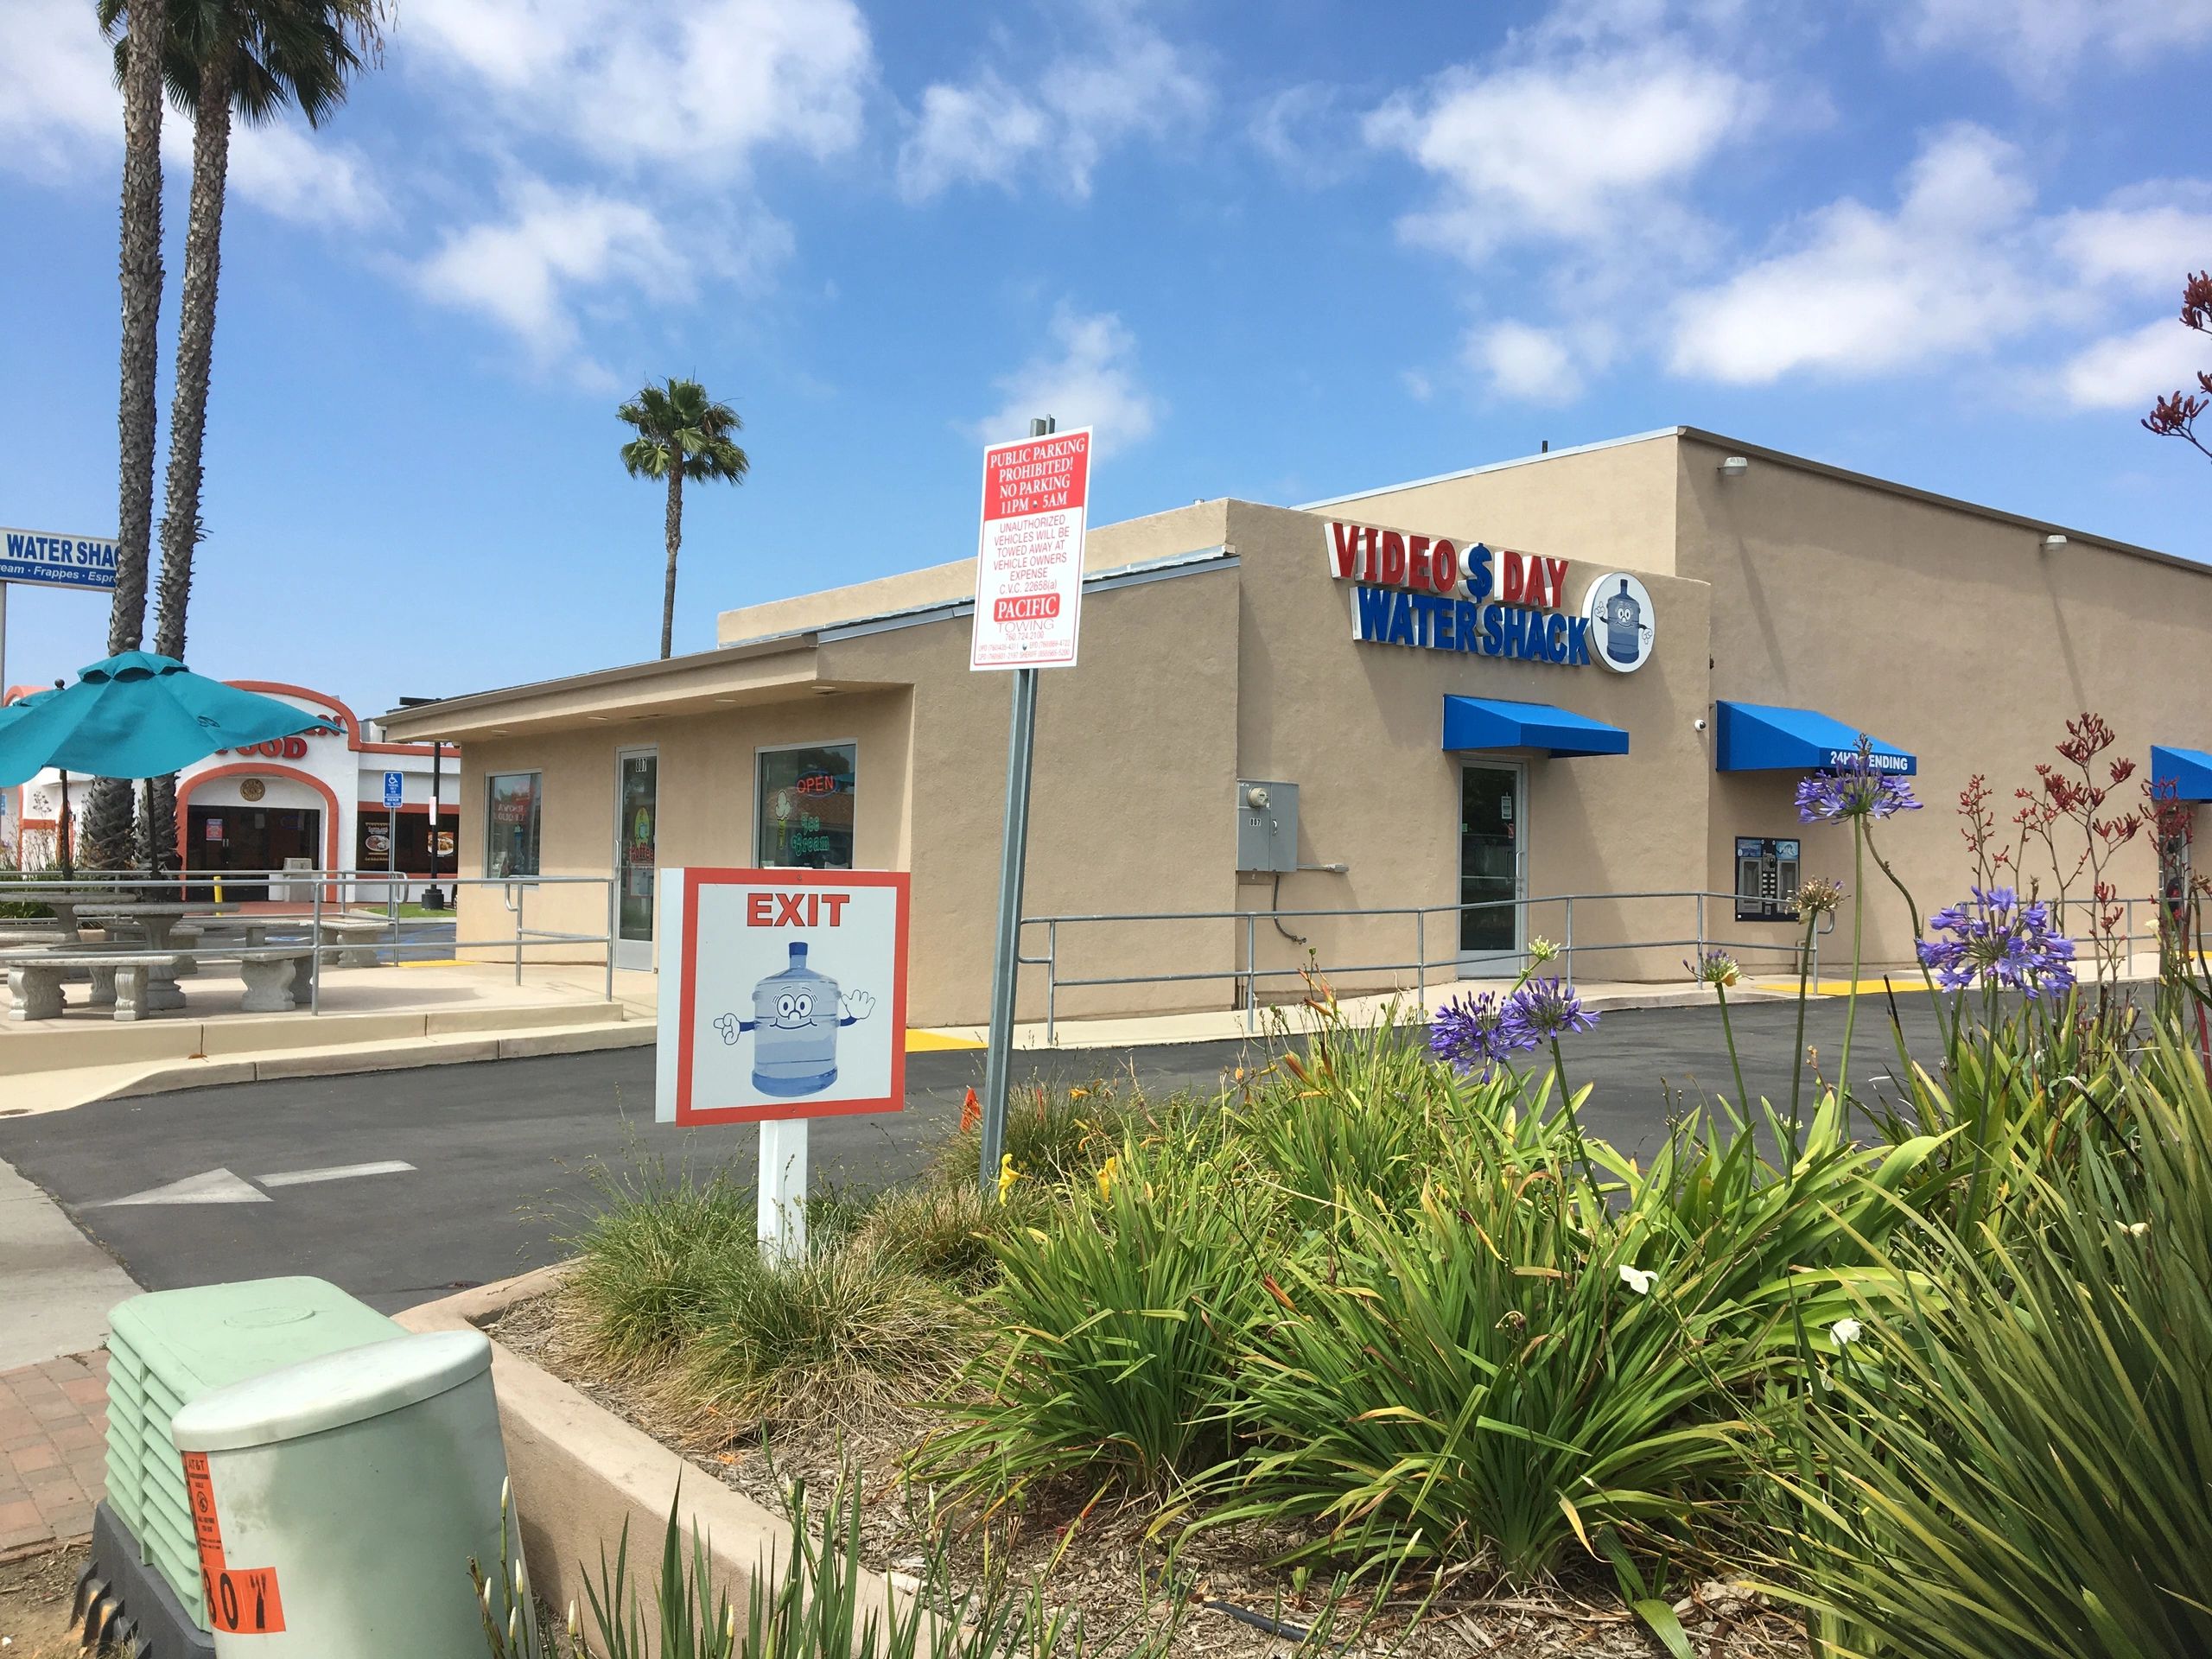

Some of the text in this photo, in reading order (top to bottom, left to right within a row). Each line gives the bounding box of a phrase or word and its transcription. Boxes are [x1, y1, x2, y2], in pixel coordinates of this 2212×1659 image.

[990, 437, 1085, 468] PUBLIC PARKING
[999, 456, 1073, 483] PROHIBITED!
[1000, 474, 1071, 499] NO PARKING
[1001, 491, 1067, 514] 11PM 5AM
[1000, 514, 1065, 533] UNAUTHORIZED
[995, 525, 1070, 546] VEHICLES WILL BE
[7, 533, 73, 563] WATER
[997, 539, 1065, 558] TOWED AWAY AT
[34, 566, 79, 579] Frappes
[994, 552, 1067, 570] VEHICLE OWNERS
[1327, 522, 1457, 593] VIDEO
[1497, 550, 1568, 608] DAY
[1010, 567, 1048, 581] EXPENSE
[997, 596, 1057, 619] PACIFIC
[997, 619, 1055, 633] TOWING
[1354, 586, 1591, 666] WATER SHACK
[215, 736, 308, 759] OD
[1864, 753, 1908, 771] ENDING
[796, 775, 835, 793] OPEN
[747, 893, 850, 927] EXIT
